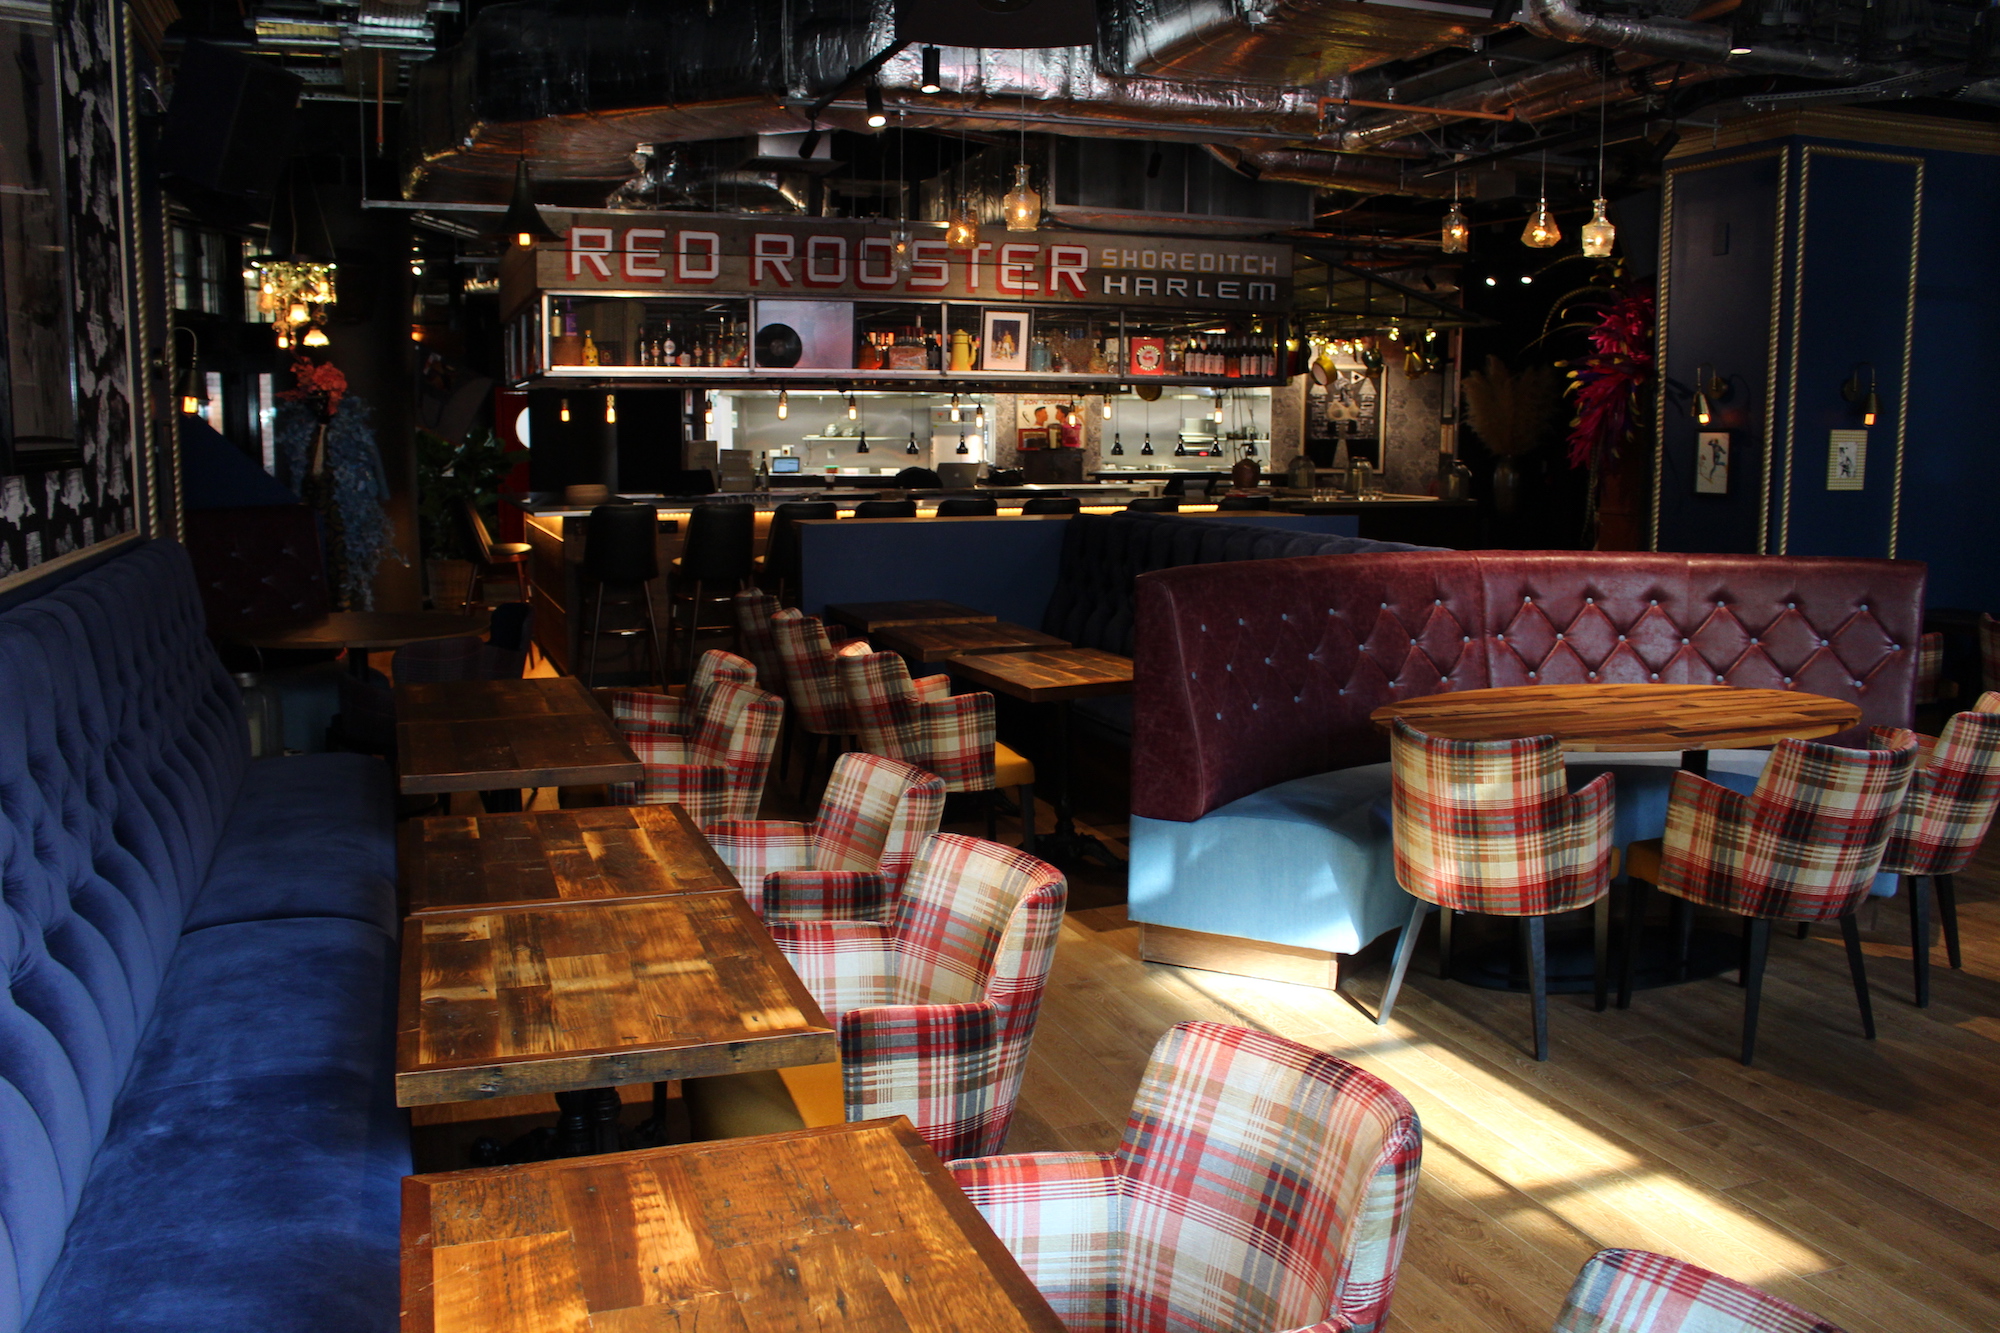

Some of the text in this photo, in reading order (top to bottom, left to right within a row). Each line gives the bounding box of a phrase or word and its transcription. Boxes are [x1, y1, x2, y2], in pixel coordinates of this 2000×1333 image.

[565, 226, 1089, 298] RED ROOSTER
[1102, 248, 1277, 275] SHOREDITCH
[1103, 275, 1276, 301] HARLEM
